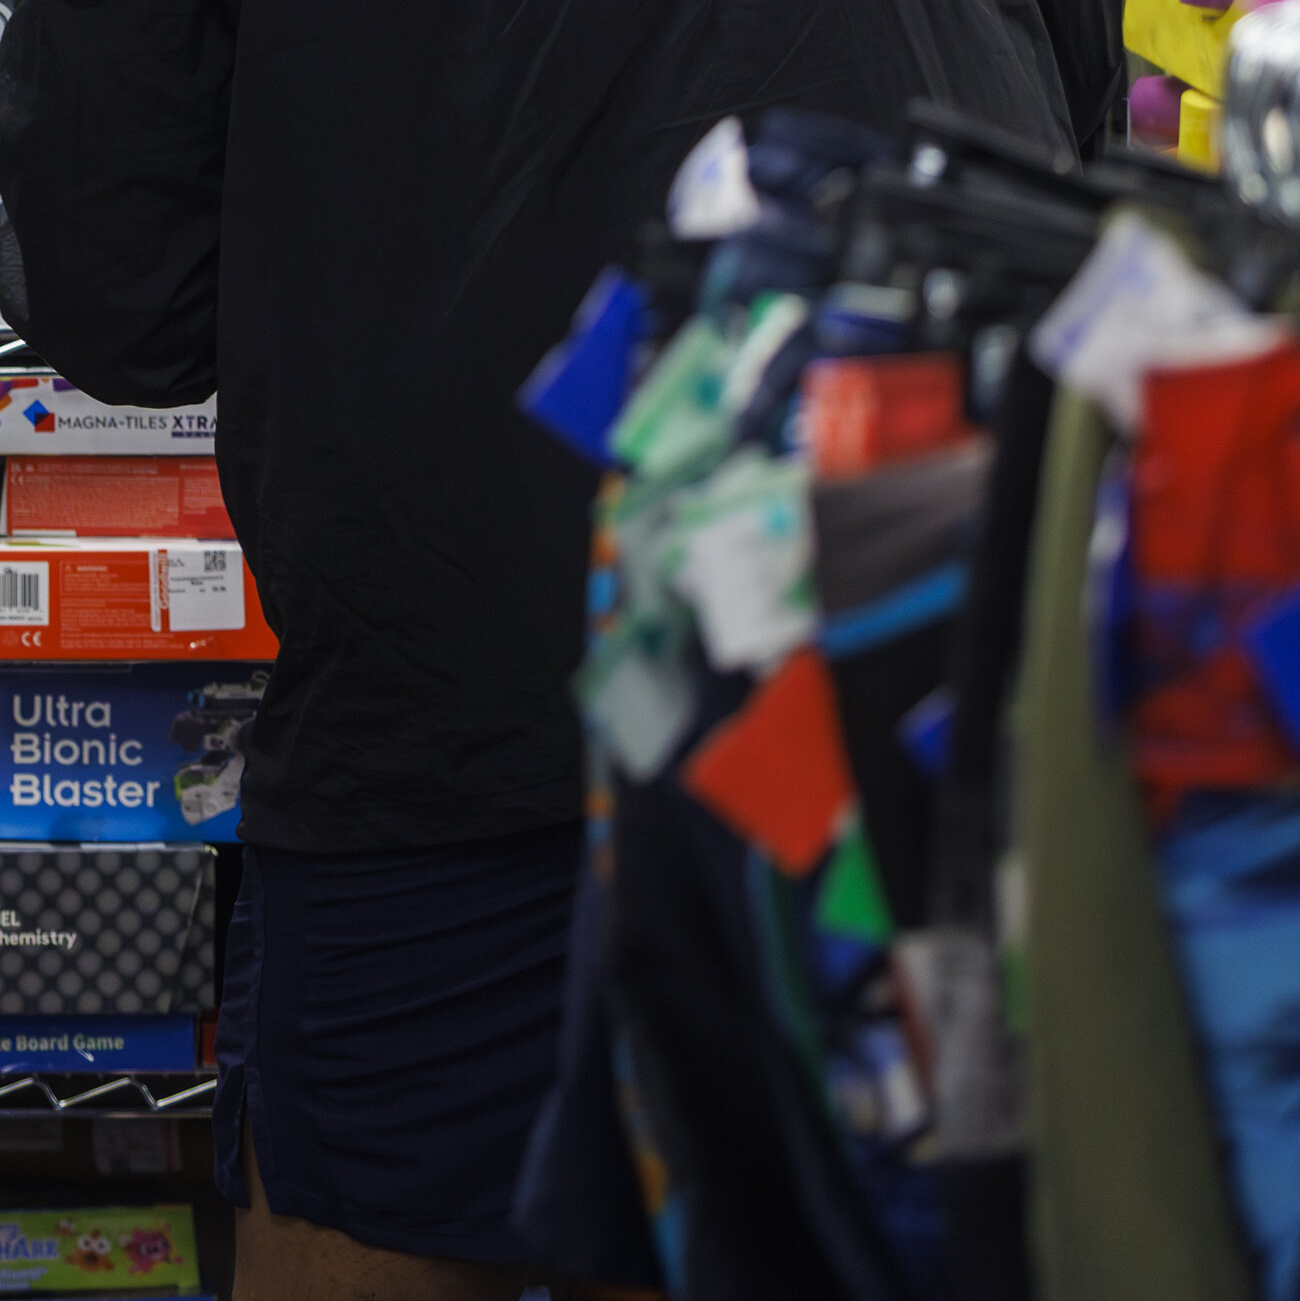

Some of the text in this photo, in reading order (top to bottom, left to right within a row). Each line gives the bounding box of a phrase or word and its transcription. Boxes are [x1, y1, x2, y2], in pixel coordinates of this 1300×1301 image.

[57, 414, 168, 430] MAGNA-TILES
[12, 695, 112, 728] Ultra
[11, 733, 143, 766] Bionic
[10, 774, 160, 807] Blaster
[15, 1035, 69, 1052] Board
[72, 1034, 125, 1052] Game
